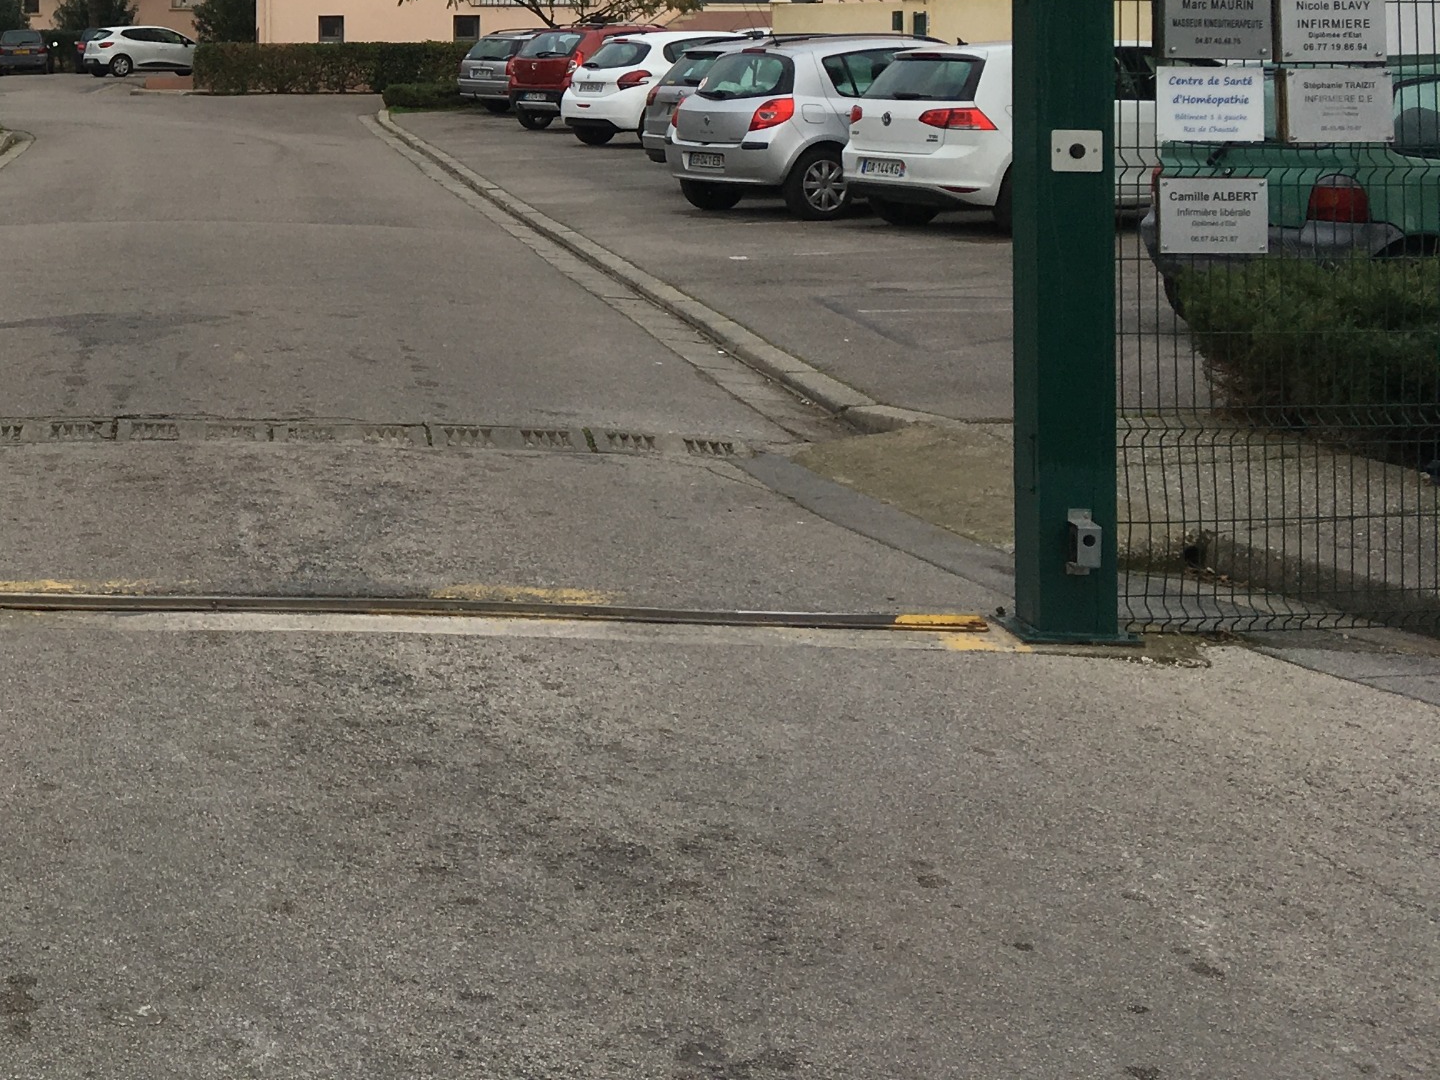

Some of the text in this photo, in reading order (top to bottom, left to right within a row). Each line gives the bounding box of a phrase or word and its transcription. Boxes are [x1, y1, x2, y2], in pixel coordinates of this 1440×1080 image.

[1182, 0, 1254, 11] Marc MAURIN
[1296, 0, 1371, 11] Nicole BLAVY
[1297, 18, 1371, 29] INFIRMIERE
[1168, 76, 1253, 86] Centre de Santé
[1172, 94, 1250, 108] d'Homéopathie
[1169, 191, 1258, 201] Camille ALBERT
[1177, 208, 1251, 217] Infirmière libérale
